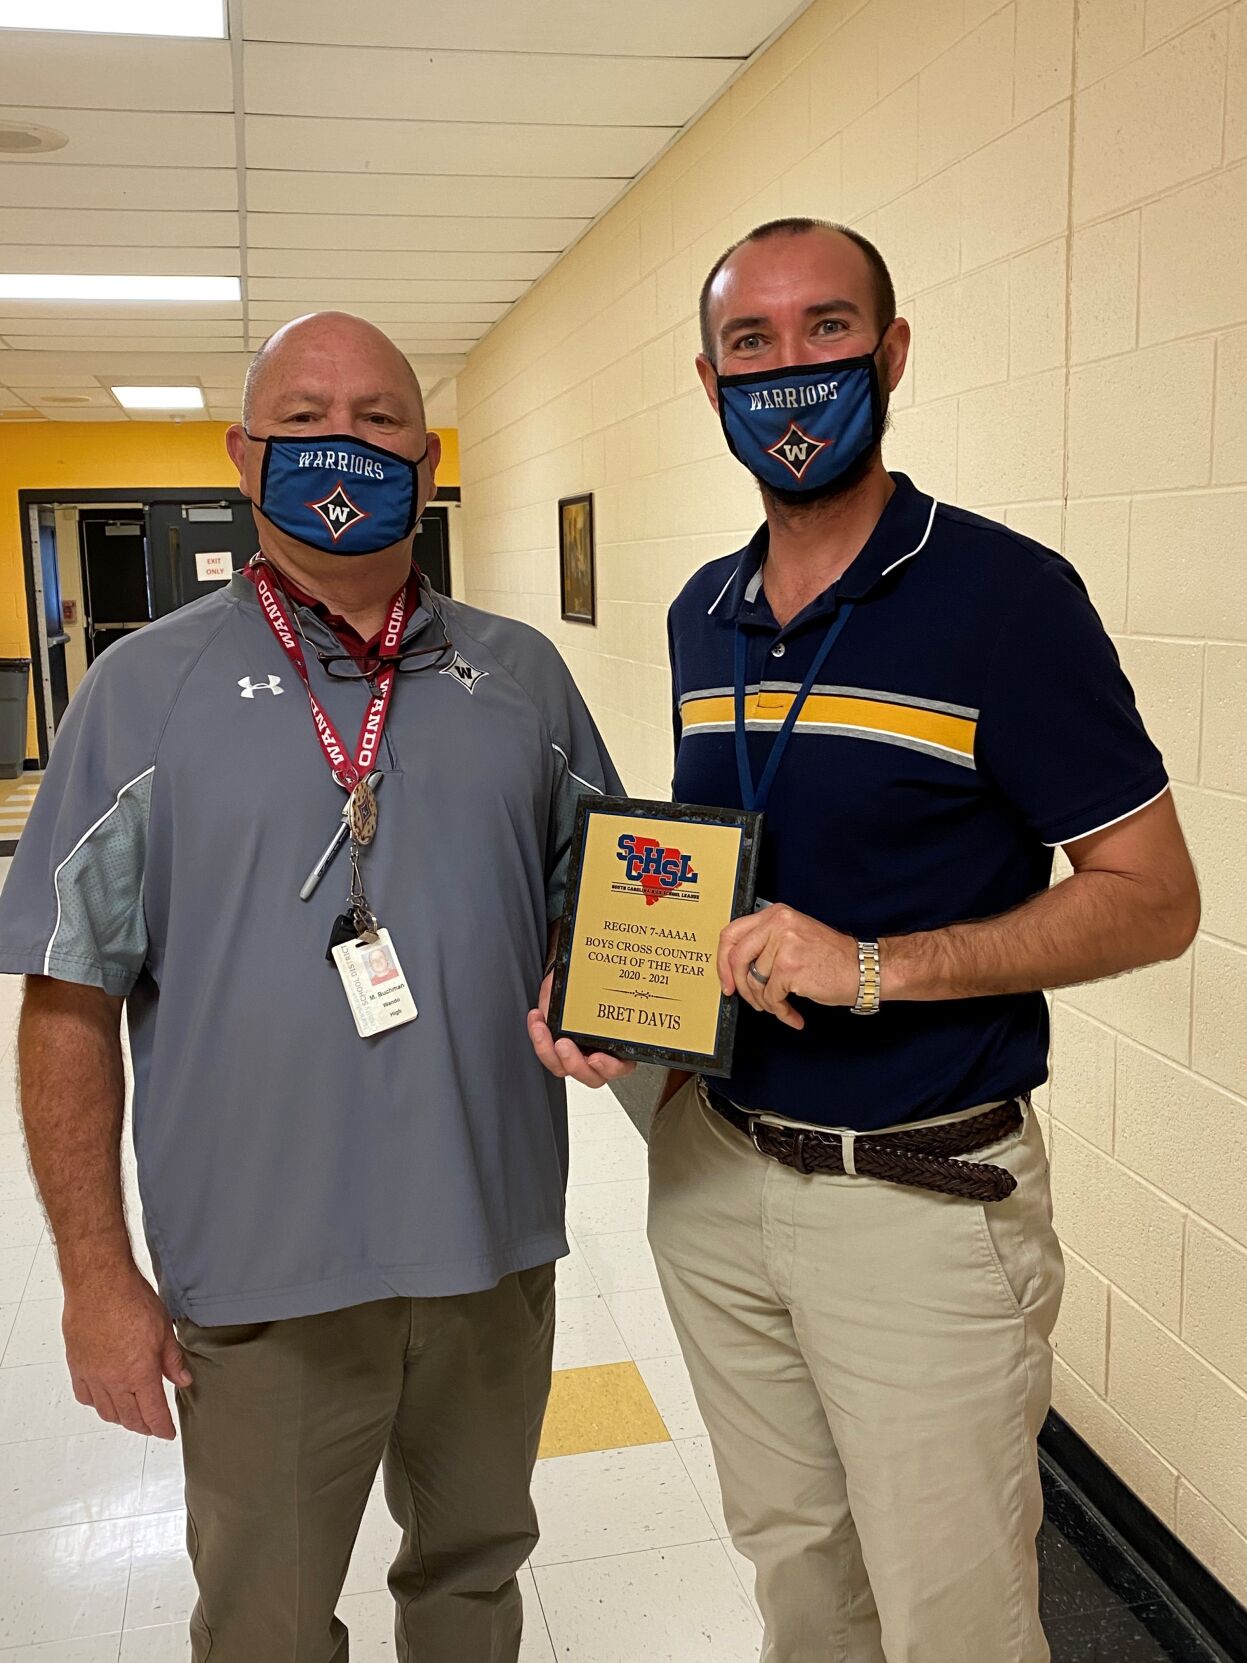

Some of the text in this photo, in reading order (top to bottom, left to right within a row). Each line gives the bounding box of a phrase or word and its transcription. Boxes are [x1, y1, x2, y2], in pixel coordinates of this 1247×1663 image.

[748, 382, 839, 411] WARRIORS
[783, 442, 808, 461] W
[298, 451, 384, 480] WARRIORS
[327, 504, 350, 523] W
[258, 580, 295, 649] WANDO
[454, 665, 472, 680] W
[604, 920, 697, 942] REGION 7-AAAAA
[585, 936, 712, 963] BOYS CROSS COUNTRY
[588, 952, 705, 977] COACH OF THE YEAR
[618, 968, 641, 981] 2020
[648, 974, 670, 985] 2021
[382, 998, 401, 1008] Wando
[597, 1003, 681, 1031] BRET DAVIS
